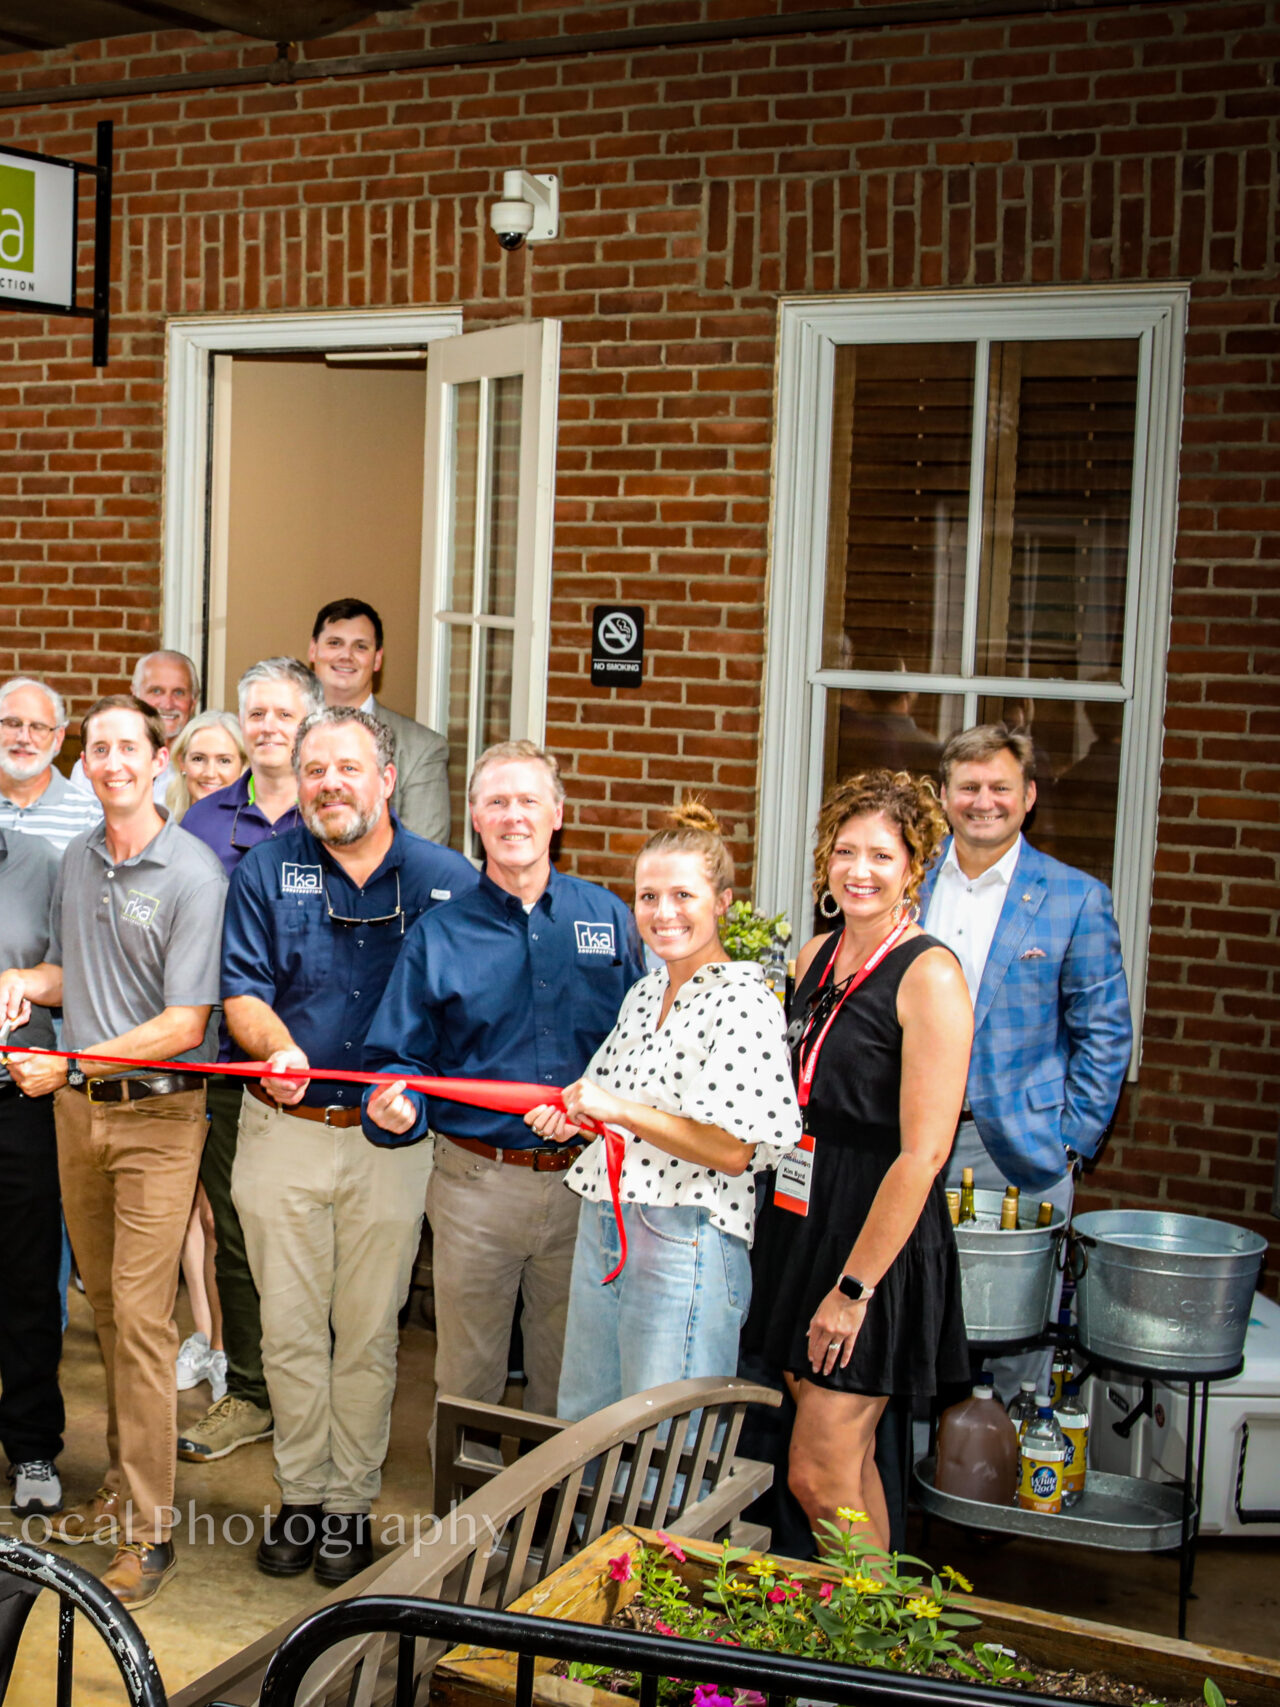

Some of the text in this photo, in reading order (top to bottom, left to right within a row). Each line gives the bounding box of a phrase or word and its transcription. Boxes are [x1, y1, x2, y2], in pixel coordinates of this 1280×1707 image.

[593, 662, 640, 672] NO SMOKING
[286, 867, 318, 888] rka
[124, 897, 151, 921] rka
[580, 926, 611, 948] rka
[783, 1166, 806, 1180] Kim Byrd
[1030, 1475, 1058, 1487] White
[1033, 1484, 1057, 1494] Rock
